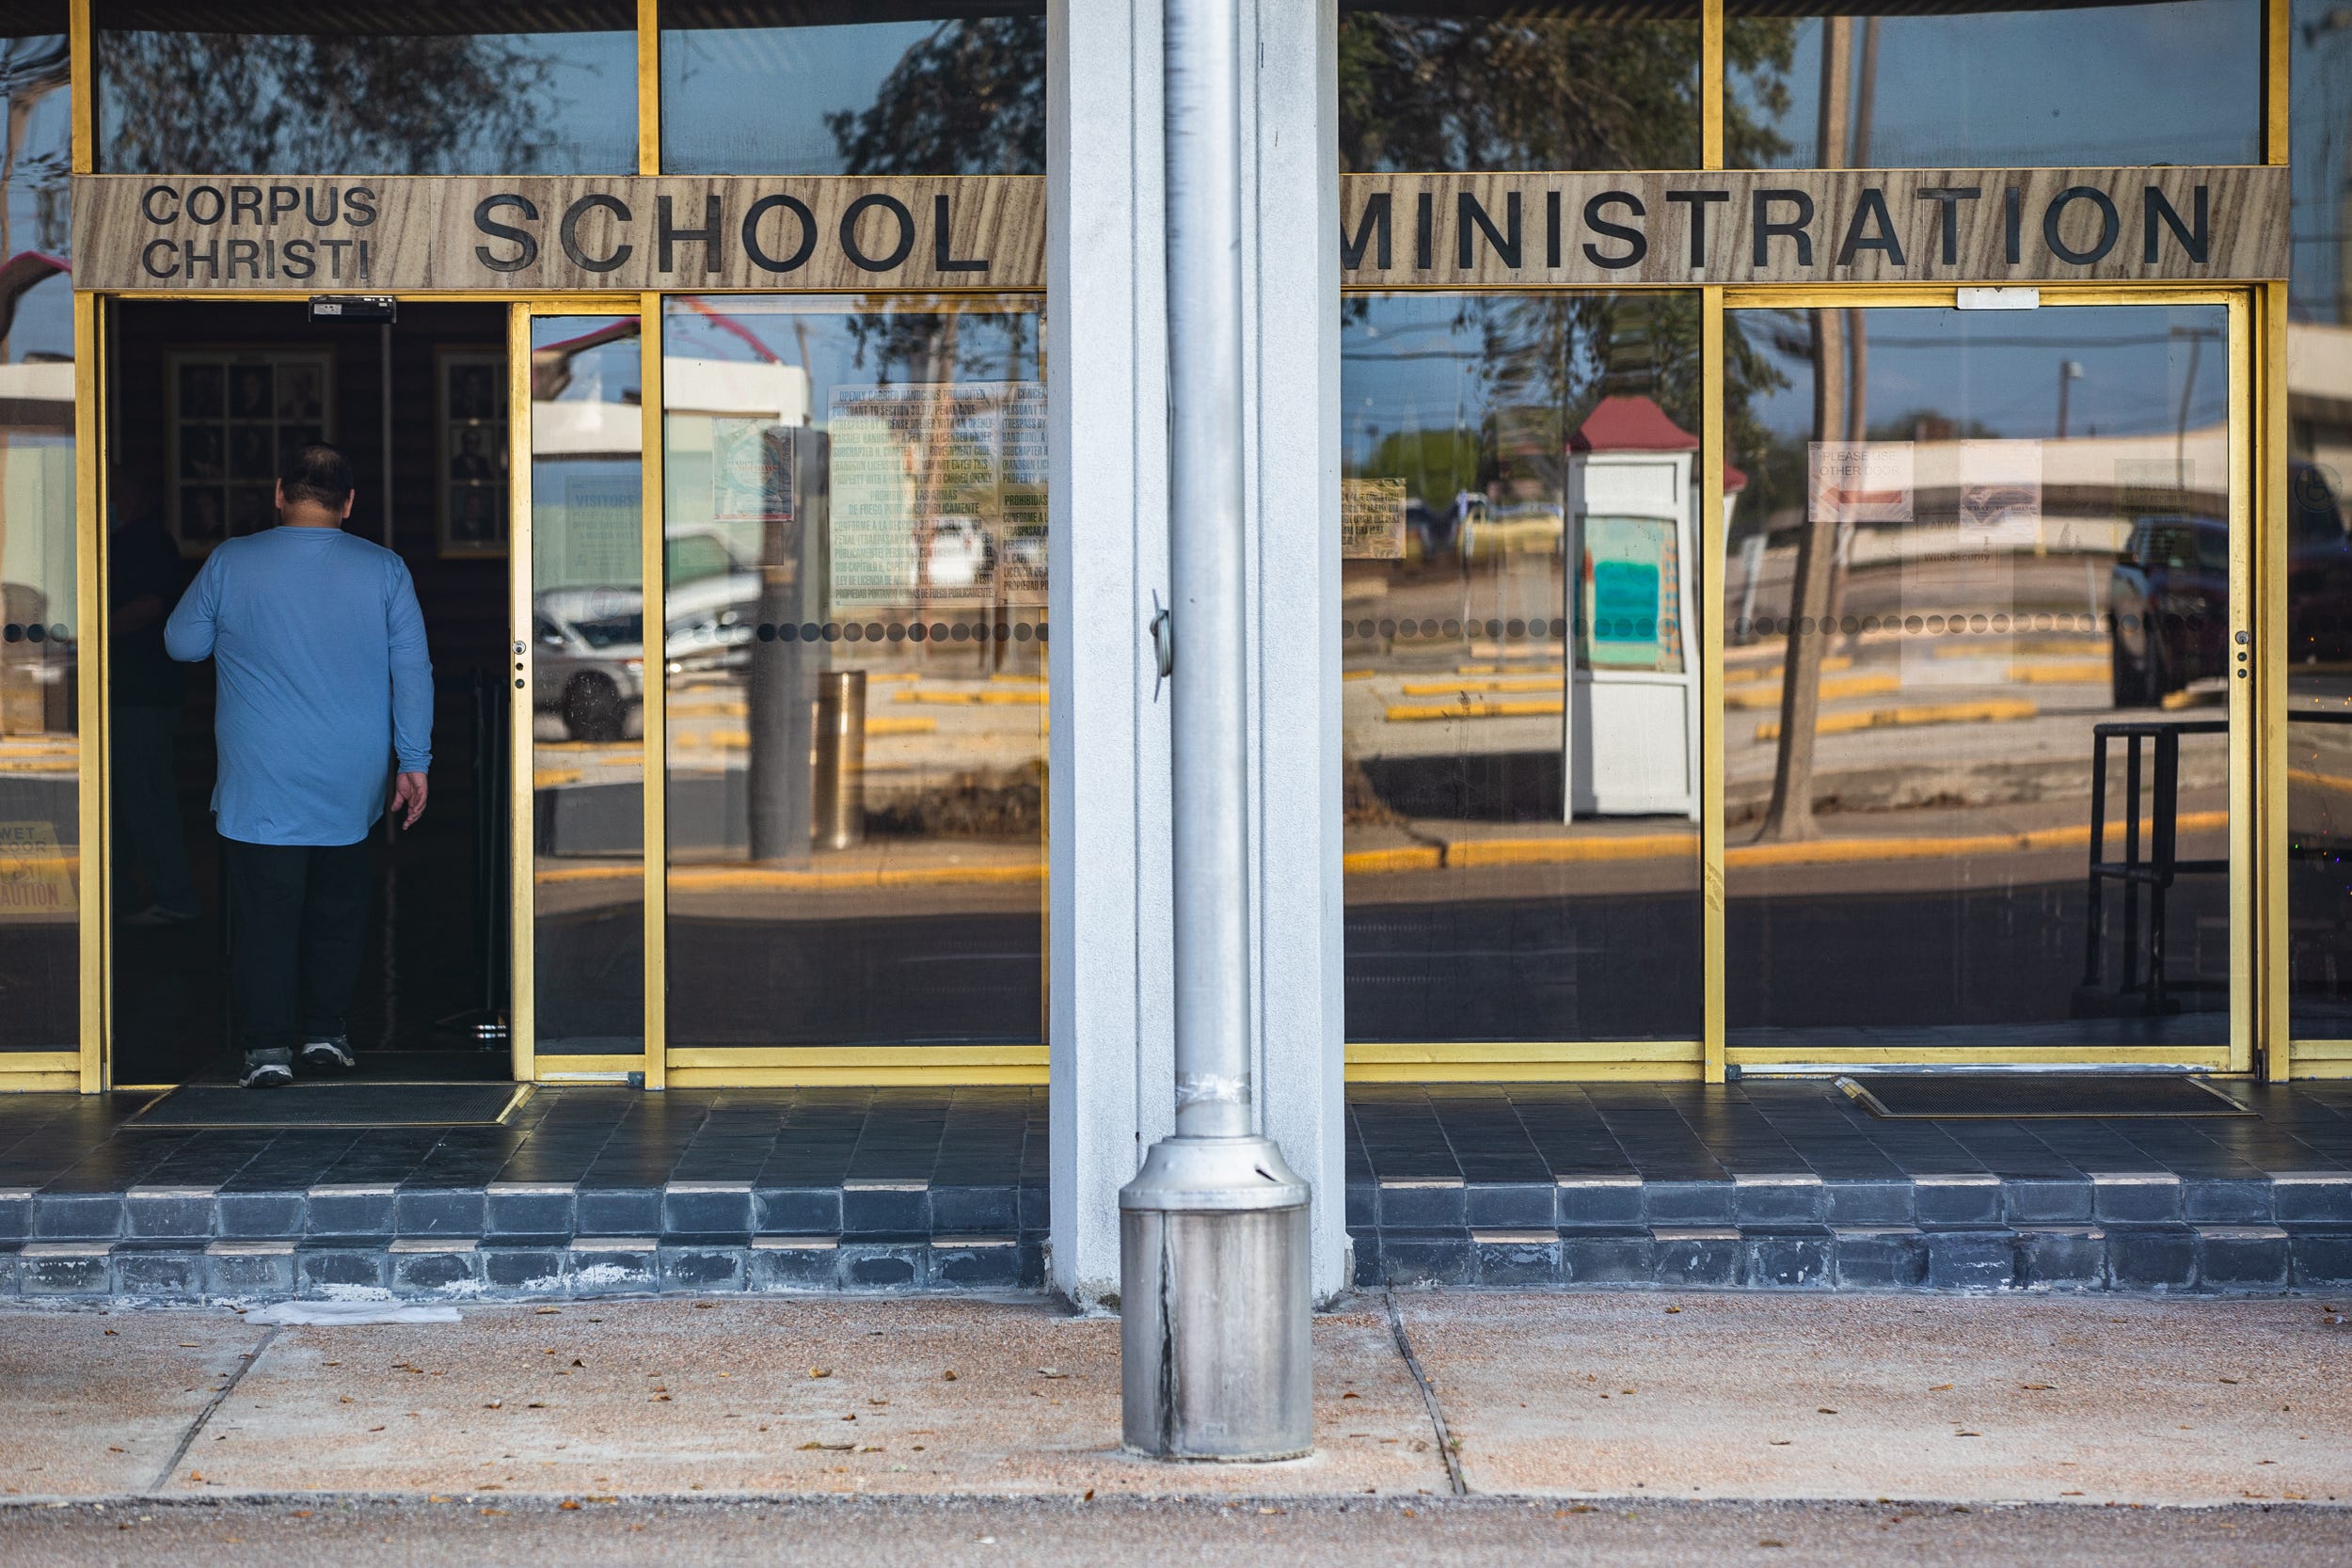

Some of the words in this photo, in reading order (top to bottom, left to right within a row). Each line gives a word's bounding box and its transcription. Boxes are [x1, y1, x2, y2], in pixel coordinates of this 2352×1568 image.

[142, 185, 377, 227] CORPUS
[473, 194, 989, 273] SCHOOL
[1340, 185, 2209, 270] MINISTRATION
[142, 239, 369, 279] CHRISTI
[839, 390, 866, 402] OPENLY
[868, 389, 898, 402] CARRIED
[833, 405, 867, 416] PURSUANT
[870, 405, 879, 416] TO
[881, 405, 909, 416] SECTION
[958, 405, 976, 415] CODE
[1003, 404, 1037, 416] PURSUANT
[871, 419, 879, 430] BY
[881, 419, 909, 430] LICENSE
[968, 419, 993, 429] OPENLY
[1003, 419, 1036, 429] (TRESPASS
[1037, 419, 1046, 429] BY
[901, 433, 907, 443] A
[936, 432, 967, 442] LICENSED
[969, 432, 992, 442] UNDER
[1003, 446, 1042, 456] SUBCHAPTER
[1823, 451, 1868, 462] PLEASE
[1873, 451, 1897, 461] USE
[937, 459, 949, 470] NOT
[952, 459, 971, 469] ENTER
[974, 459, 988, 469] THIS
[1003, 459, 1035, 470] (HANDGUN
[1820, 466, 1861, 476] OTHER
[1866, 466, 1900, 476] DOOR
[882, 474, 887, 484] A
[936, 473, 942, 483] IS
[943, 473, 968, 483] CARRIED
[1003, 473, 1037, 483] PROPERTY
[916, 489, 929, 500] LAS
[931, 489, 958, 500] ARMAS
[576, 494, 635, 508] VISITORS
[849, 504, 857, 515] DE
[860, 503, 882, 515] FUEGO
[1003, 512, 1037, 523] CONFORME
[1039, 512, 1042, 523] A
[834, 520, 869, 531] CONFORME
[873, 520, 877, 531] A
[879, 520, 887, 531] LA
[1003, 526, 1041, 536] (TRASPASAR
[1931, 520, 1944, 531] All
[857, 534, 898, 545] (TRASPASAR
[1003, 540, 1037, 549] PERSONAS
[1925, 553, 1947, 562] With
[1949, 552, 1990, 563] Security
[1003, 567, 1033, 578] LICENCIA
[850, 576, 856, 586] DE
[858, 575, 883, 585] LICENCIA
[884, 575, 892, 585] DE
[1003, 580, 1039, 591] PROPIEDAD
[835, 589, 867, 599] PROPIEDAD
[921, 588, 928, 598] DE
[930, 588, 947, 598] FUEGO
[0, 827, 35, 839] WET
